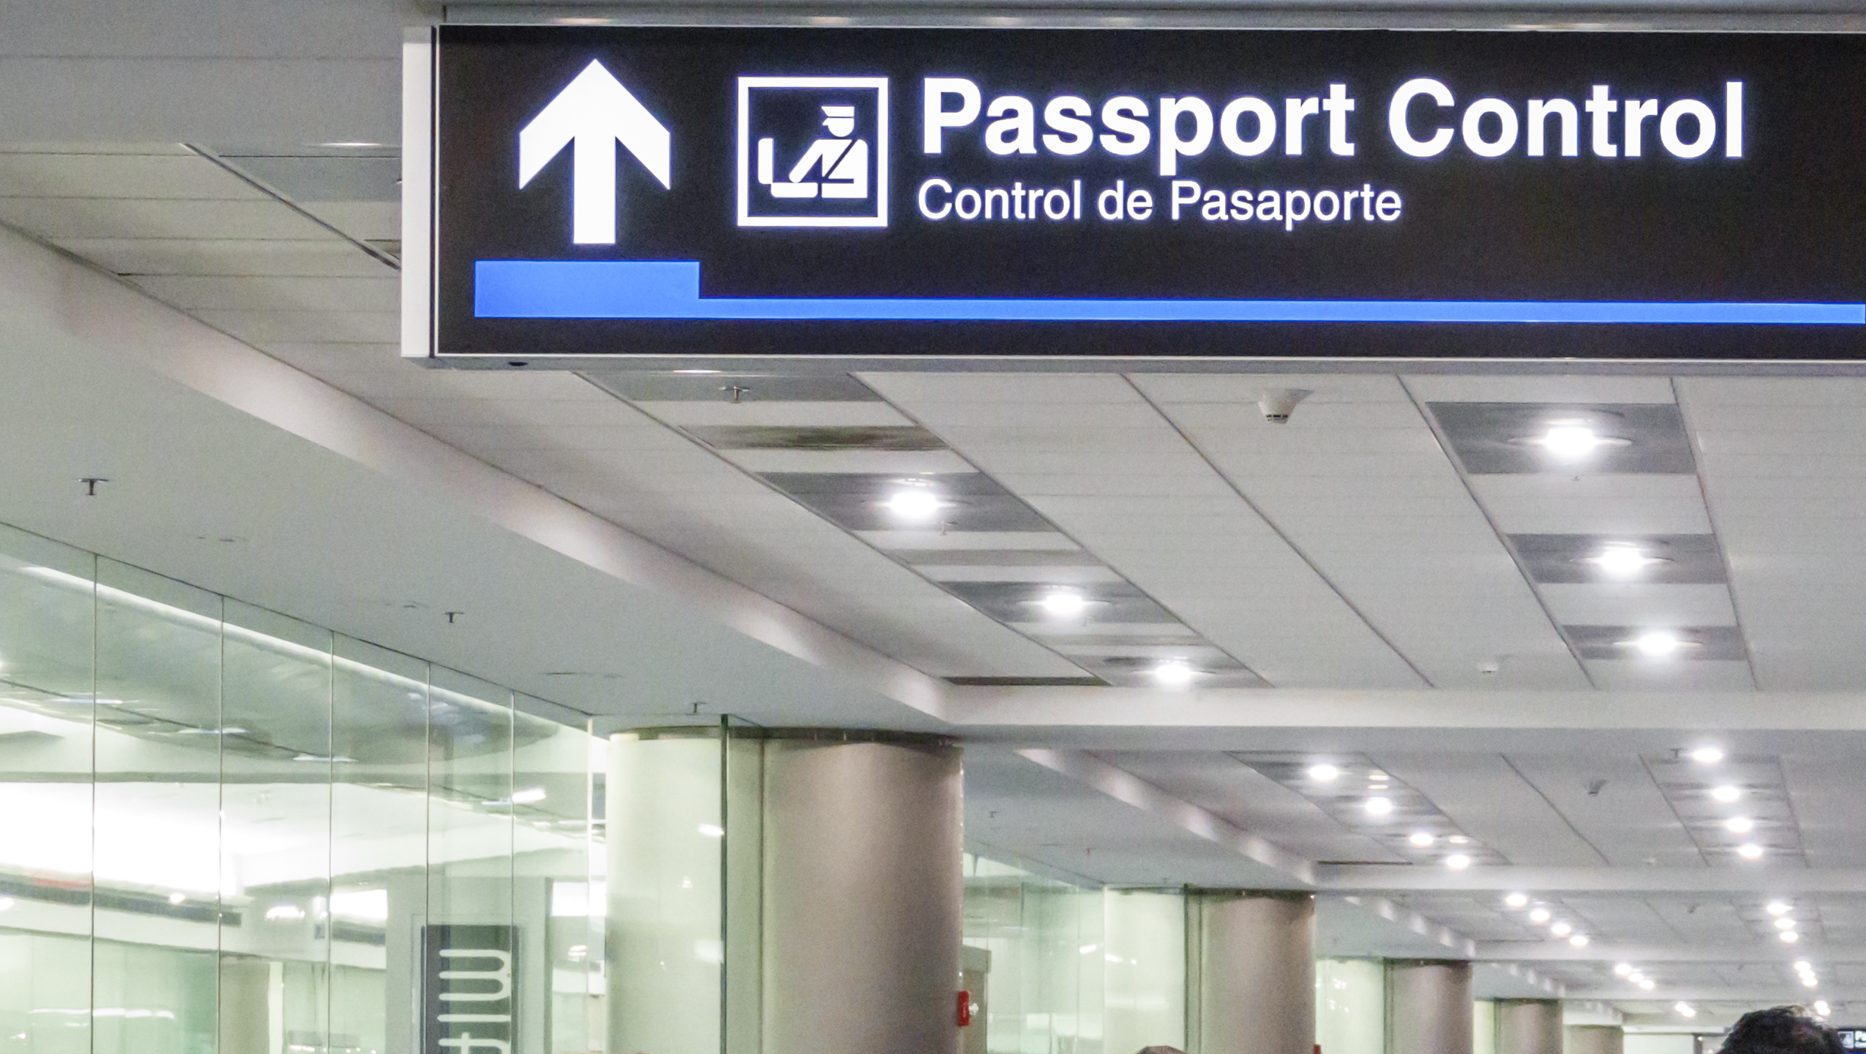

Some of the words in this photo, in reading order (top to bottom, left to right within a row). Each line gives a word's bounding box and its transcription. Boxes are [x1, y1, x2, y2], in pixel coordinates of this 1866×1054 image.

[922, 76, 1356, 177] Passport
[1387, 77, 1744, 159] Control
[917, 178, 1082, 221] Control
[1096, 179, 1154, 221] de
[1170, 179, 1402, 231] Pasaporte
